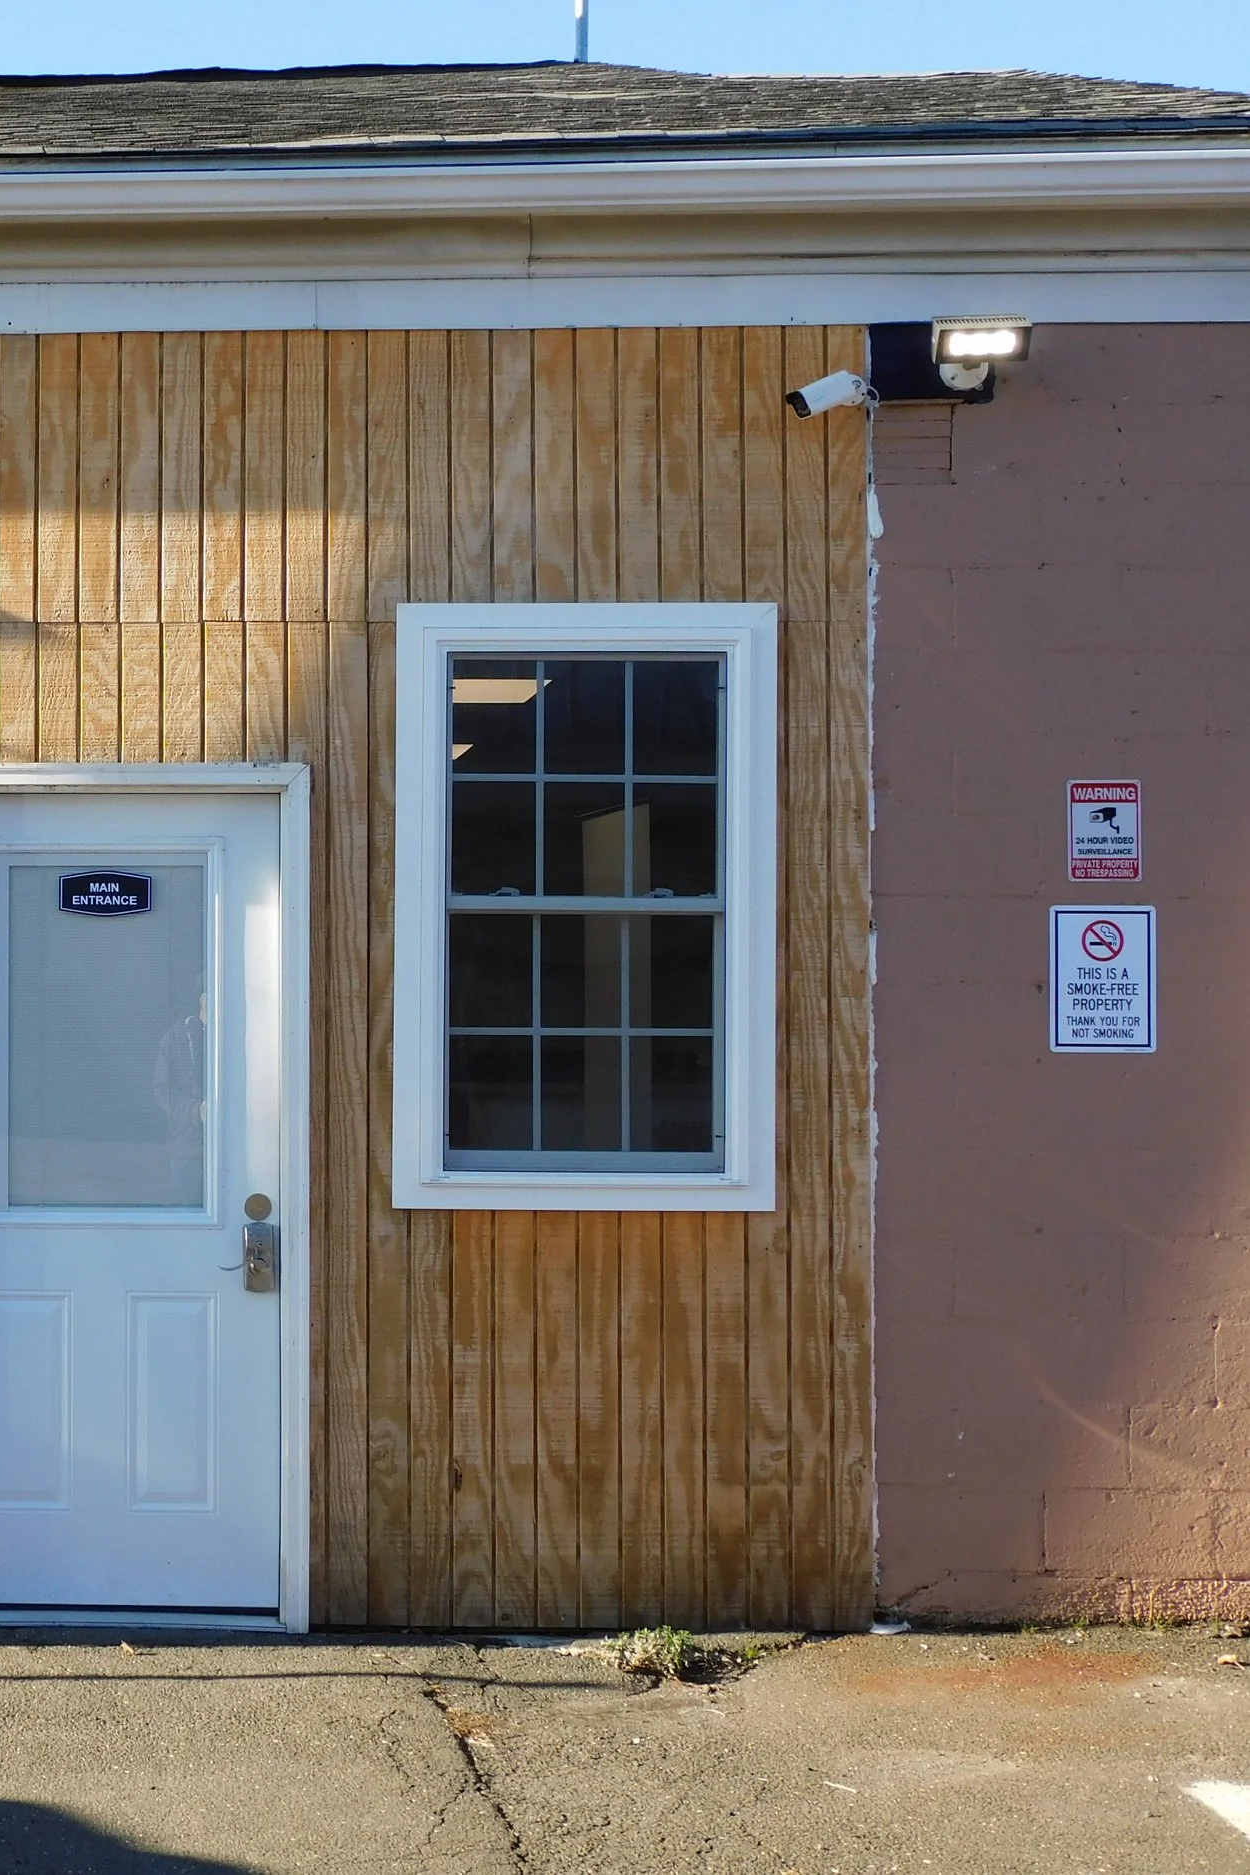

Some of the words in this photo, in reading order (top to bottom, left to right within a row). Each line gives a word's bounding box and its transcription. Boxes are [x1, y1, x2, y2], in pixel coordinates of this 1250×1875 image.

[1073, 787, 1136, 800] WARNING
[1072, 860, 1101, 868] PRIVATE
[1102, 860, 1138, 868] PROPERTY
[1075, 869, 1086, 877] NO
[1087, 869, 1134, 877] TRESPASSING
[89, 882, 120, 893] MAIN
[72, 895, 138, 906] ENTRANCE
[1077, 967, 1102, 980] THIS
[1106, 967, 1117, 980] IS
[1121, 967, 1129, 980] A
[1067, 983, 1139, 996] SMOKE-FREE
[1072, 999, 1133, 1011] PROPERTY
[1066, 1016, 1096, 1027] THANK
[1100, 1016, 1119, 1027] YOU
[1122, 1016, 1141, 1027] FOR
[1071, 1029, 1090, 1039] NOT
[1093, 1029, 1134, 1039] SMOKING
